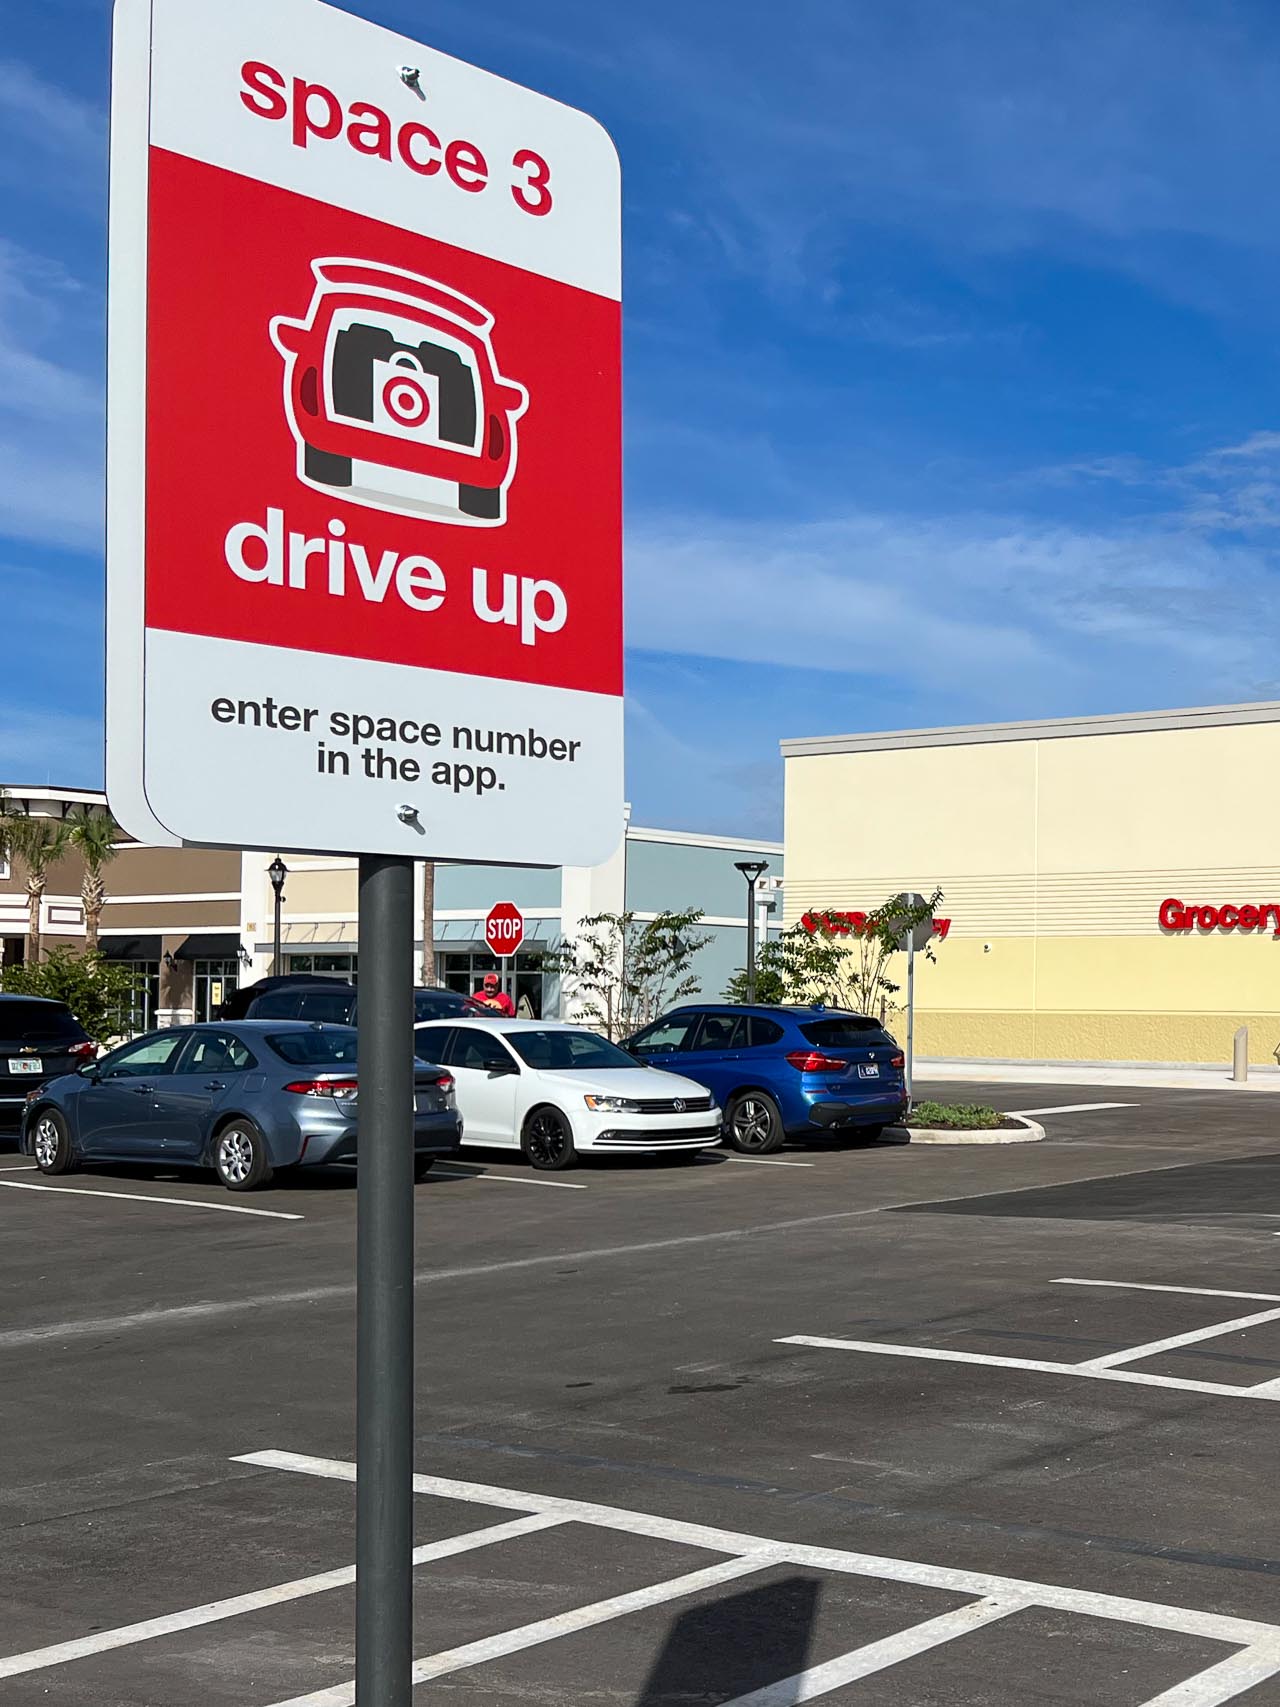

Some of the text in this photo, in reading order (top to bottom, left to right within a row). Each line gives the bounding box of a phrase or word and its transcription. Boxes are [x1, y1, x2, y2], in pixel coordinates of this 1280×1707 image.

[240, 62, 553, 217] space 3
[225, 507, 568, 646] drive up
[212, 697, 581, 762] enter space number
[317, 740, 505, 796] in the app.
[487, 918, 522, 939] STOP
